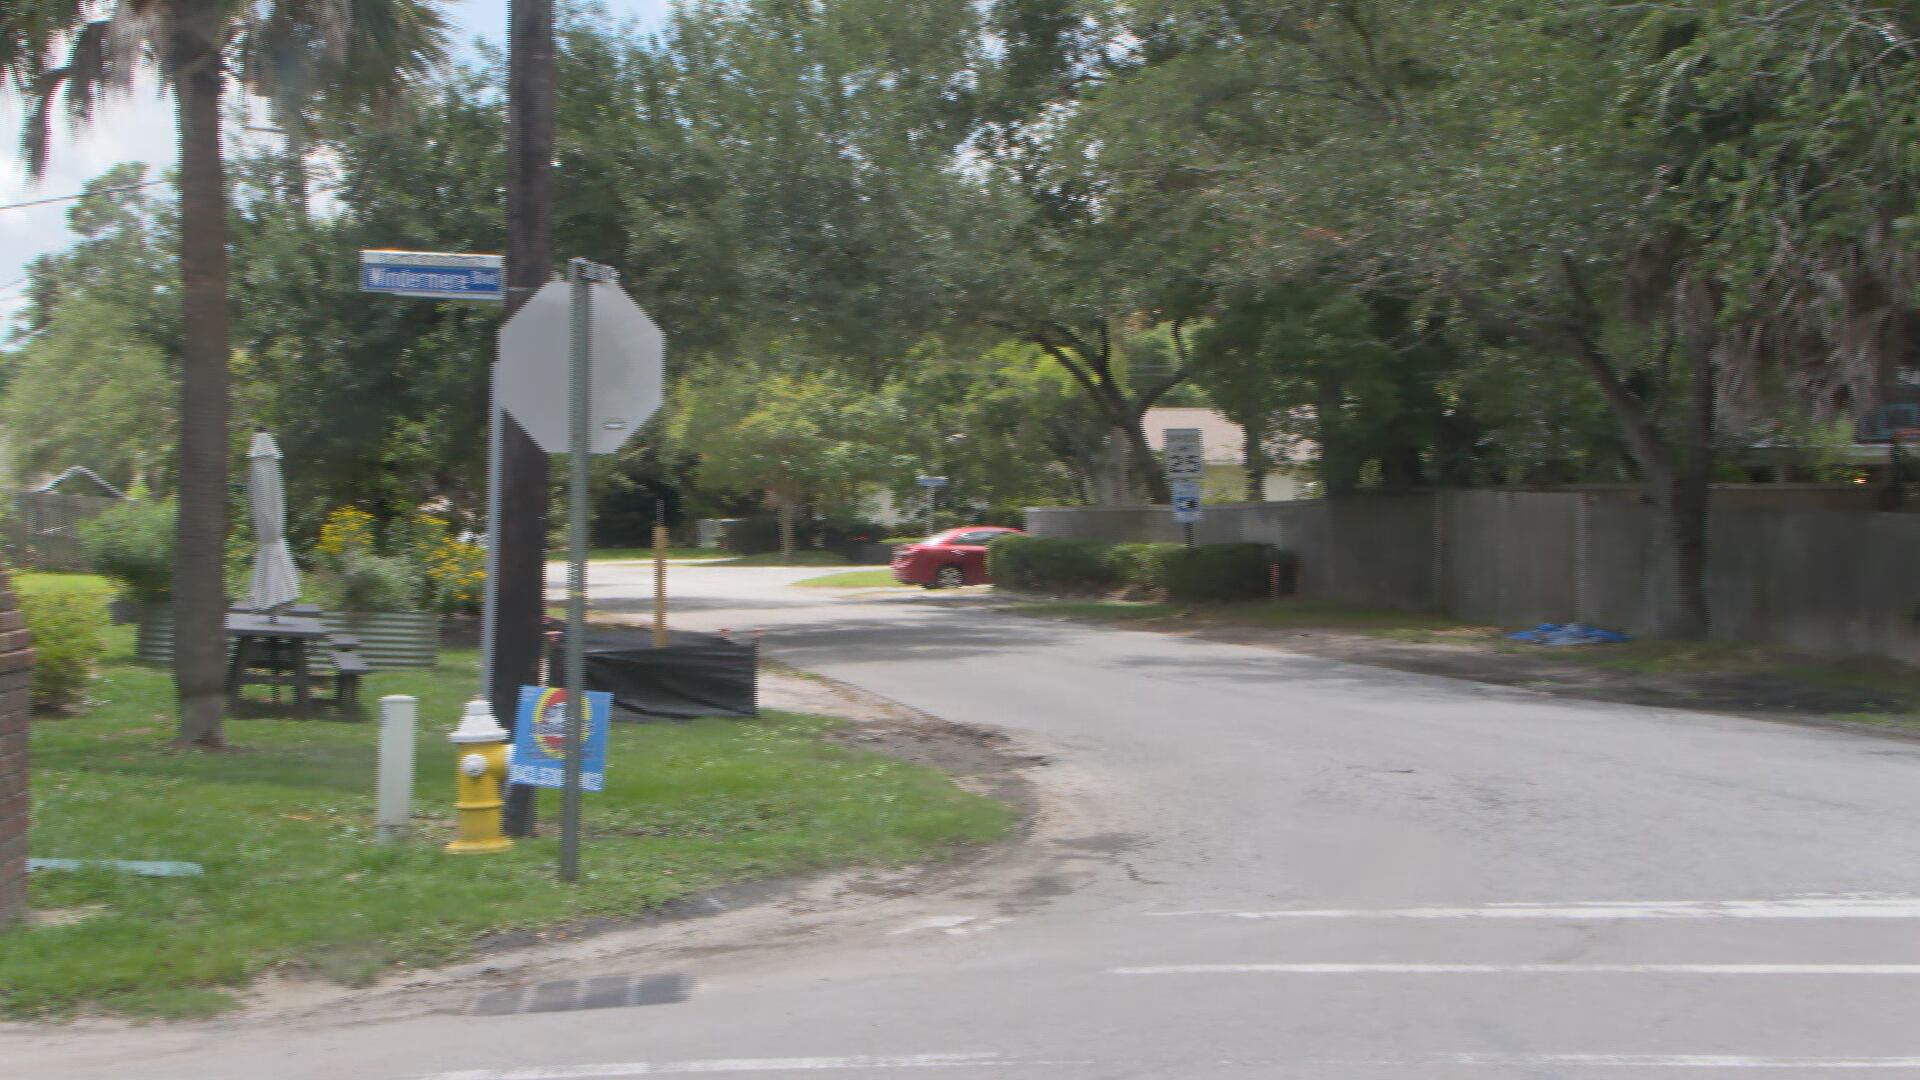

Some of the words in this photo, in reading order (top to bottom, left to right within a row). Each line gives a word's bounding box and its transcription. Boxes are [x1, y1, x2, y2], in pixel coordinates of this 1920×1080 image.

[367, 267, 470, 290] Windermere
[471, 270, 498, 286] Blvd
[1168, 455, 1200, 473] 25
